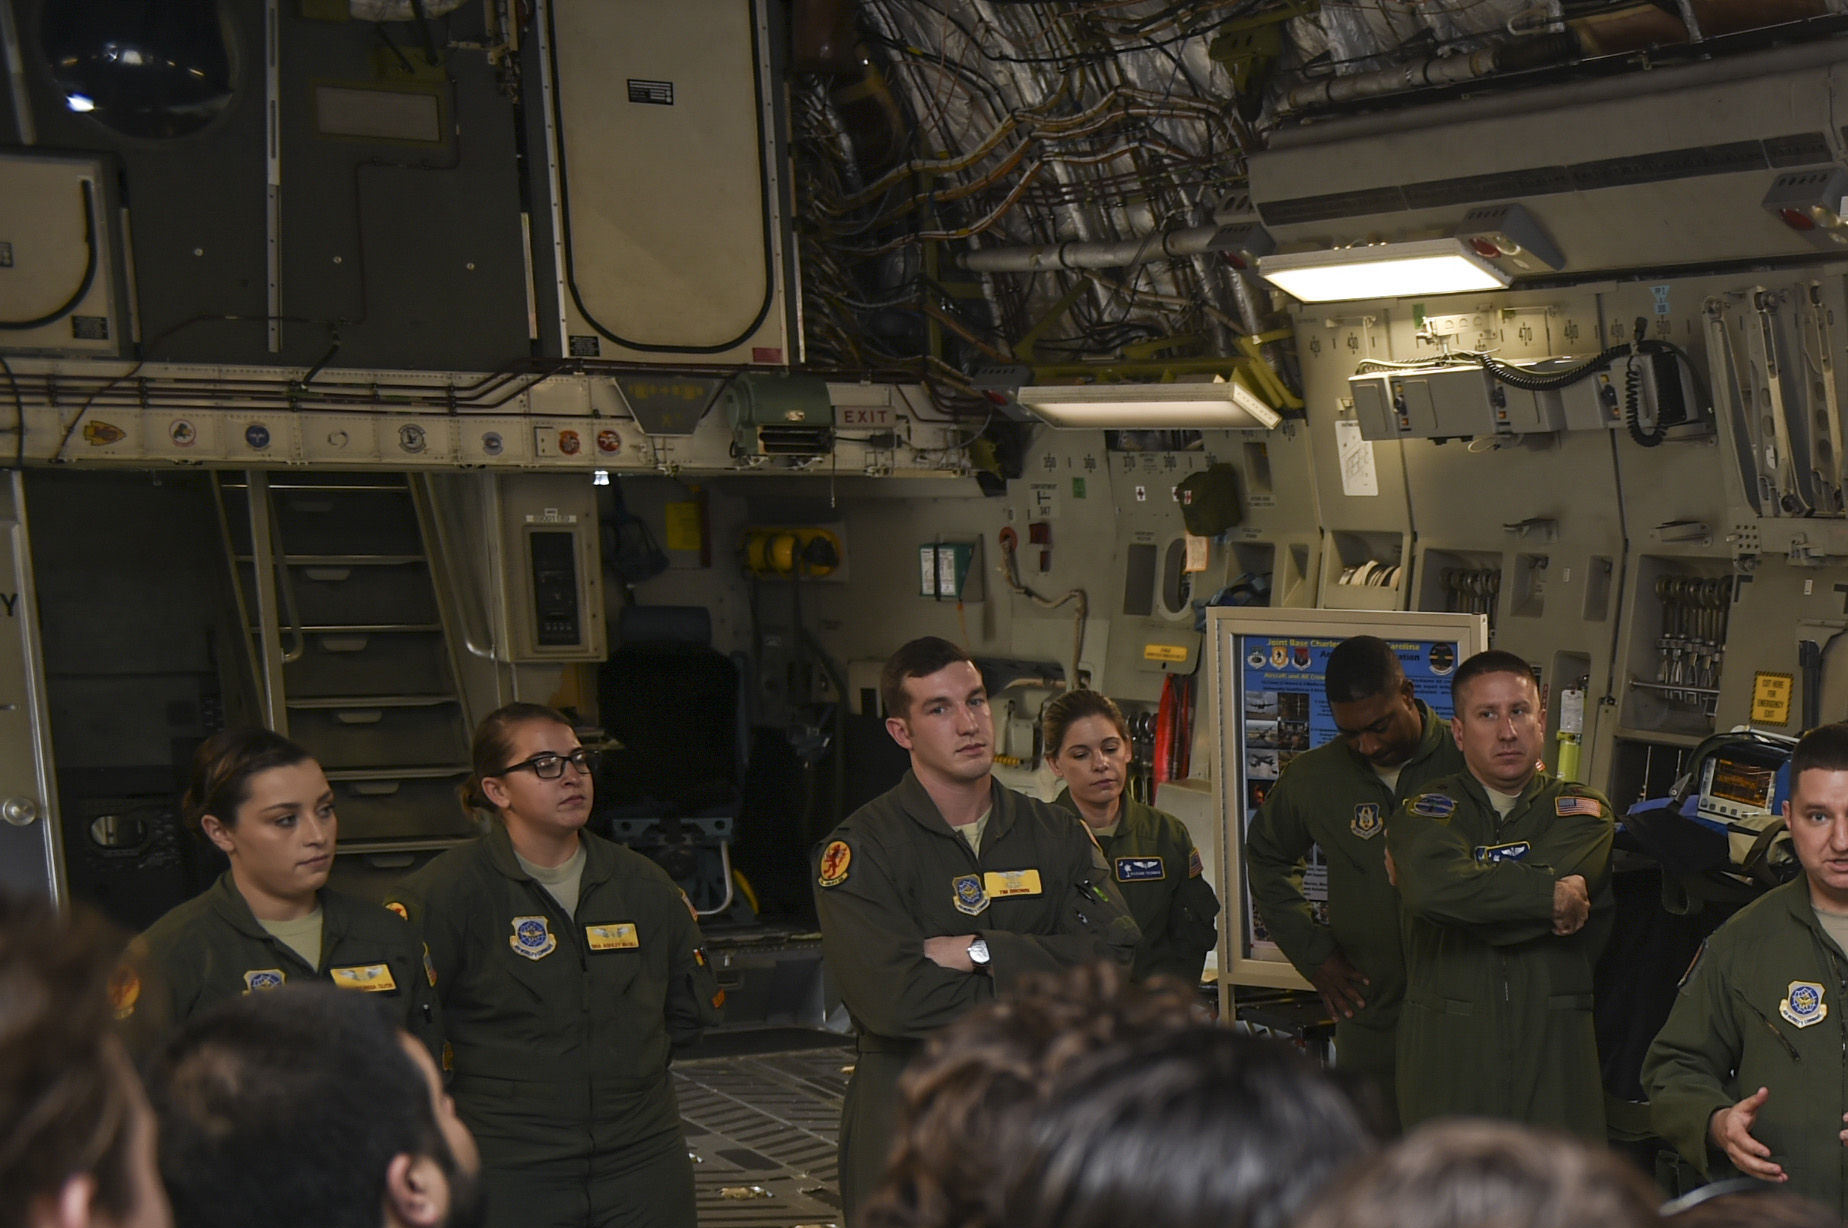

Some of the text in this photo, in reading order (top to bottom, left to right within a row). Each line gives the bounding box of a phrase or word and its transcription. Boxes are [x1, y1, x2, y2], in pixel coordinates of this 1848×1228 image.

[1519, 326, 1532, 341] 470
[844, 410, 887, 423] EXIT
[1267, 639, 1288, 647] Joint
[1290, 639, 1308, 647] Base
[1757, 699, 1784, 708] EMERGENCY
